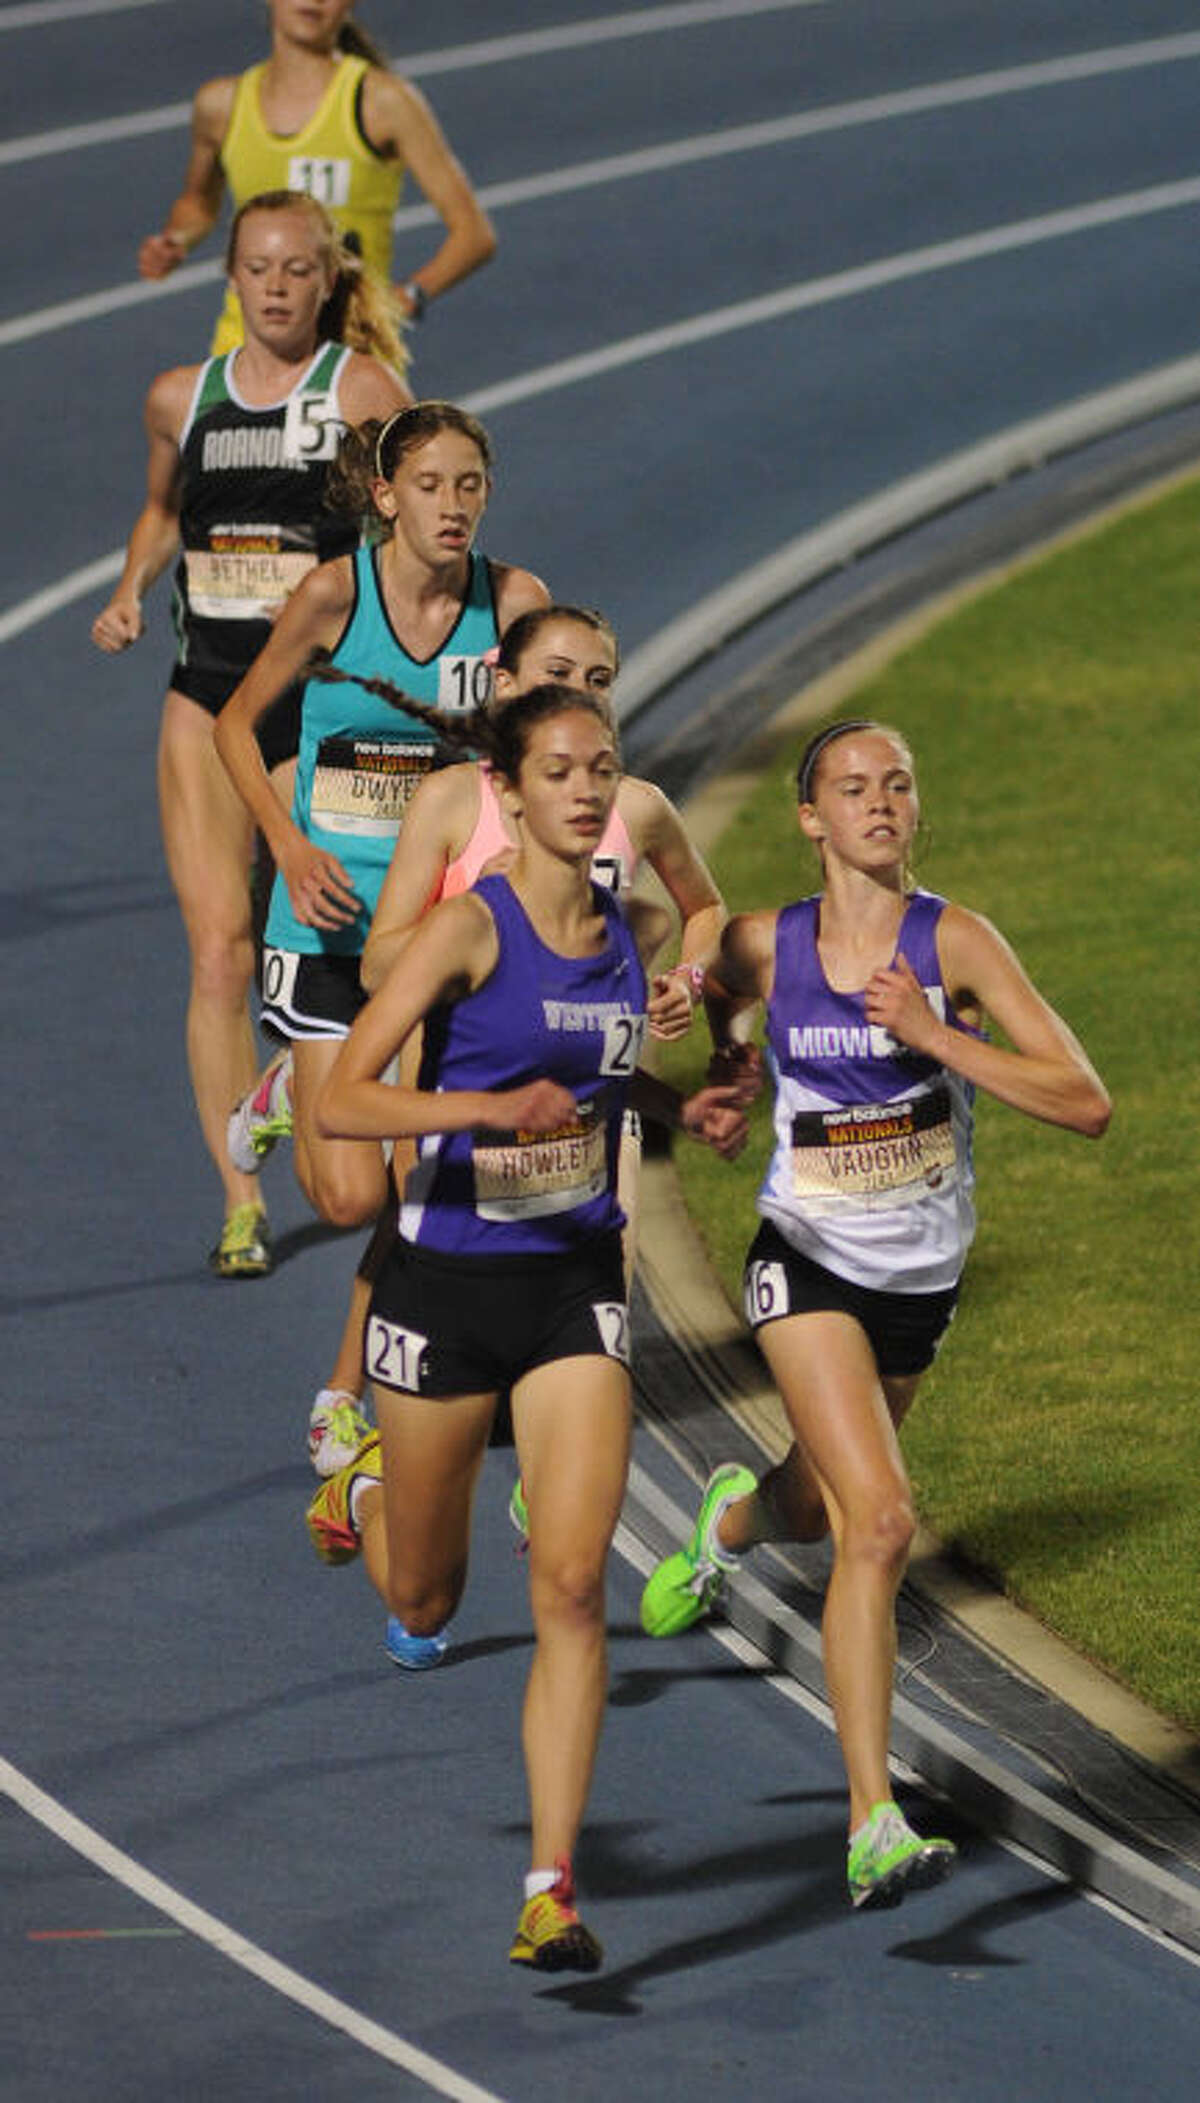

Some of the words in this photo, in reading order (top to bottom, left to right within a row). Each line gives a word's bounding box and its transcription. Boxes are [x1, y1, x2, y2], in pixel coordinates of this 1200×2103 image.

[202, 427, 309, 471] ROANO
[301, 399, 325, 453] 5
[452, 660, 491, 708] 10
[789, 1025, 868, 1059] MIDW
[826, 1114, 914, 1144] NATIONALS
[824, 1133, 923, 1179] VAUGHN
[374, 1324, 406, 1383] 21
